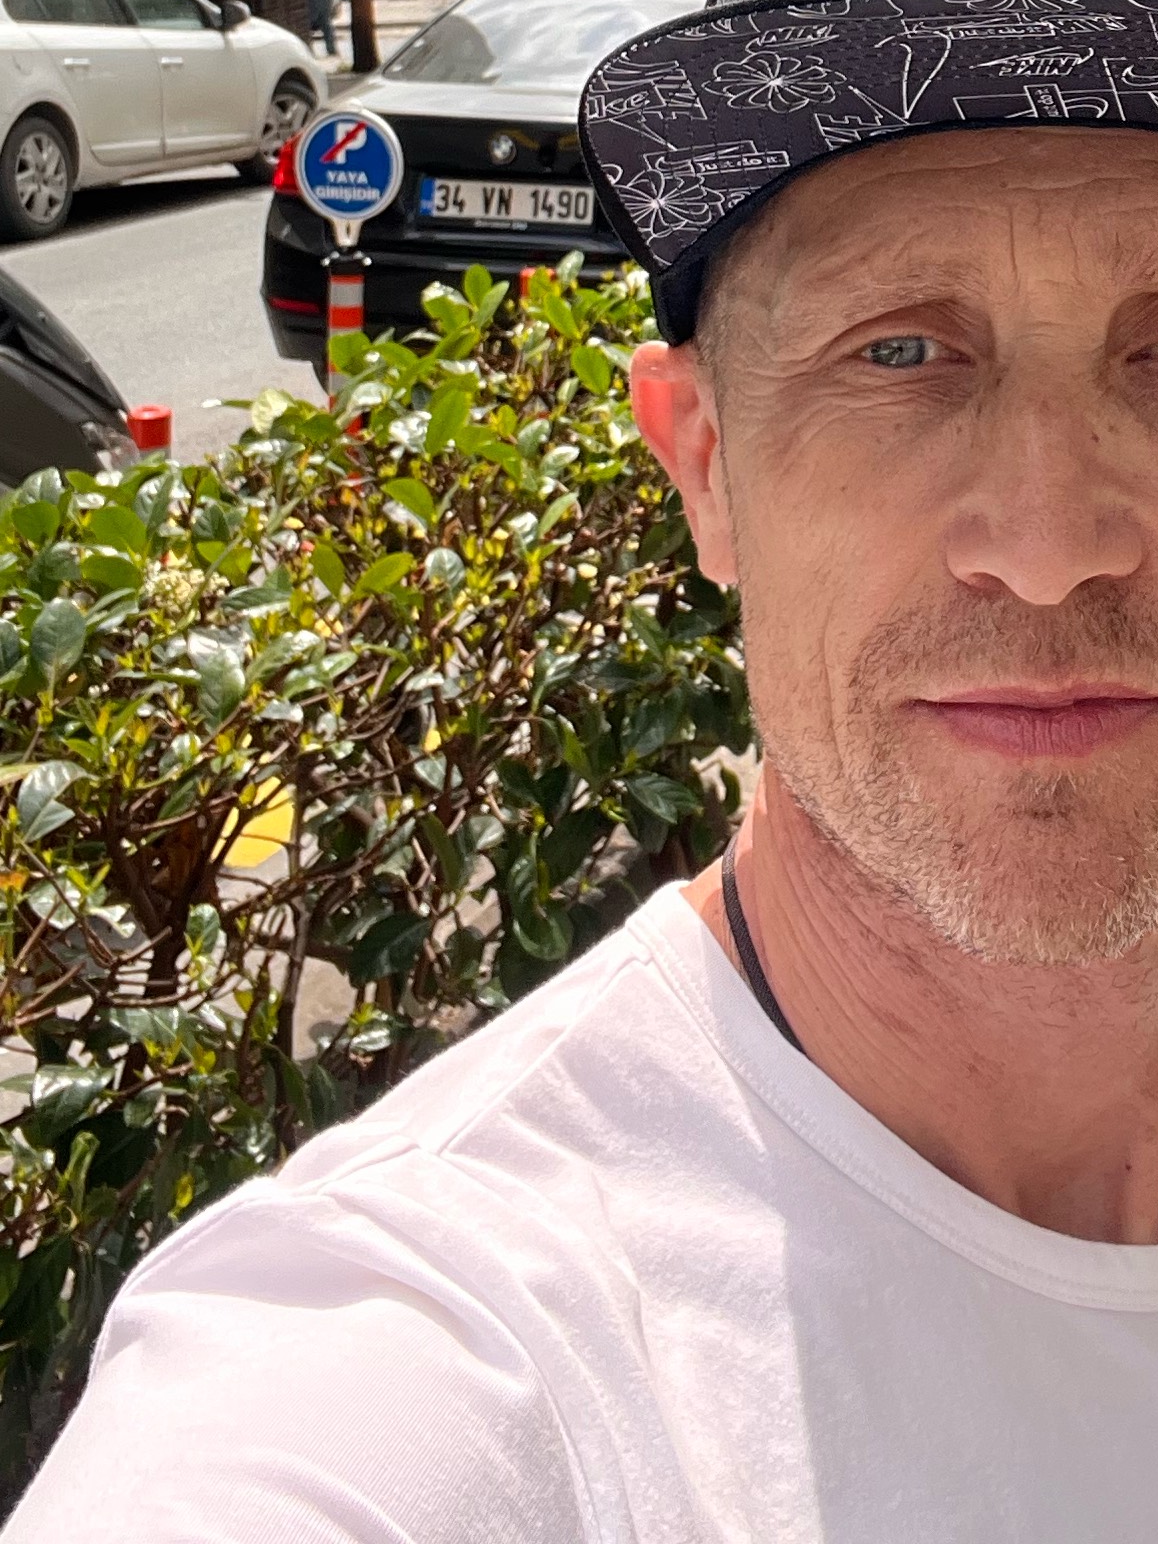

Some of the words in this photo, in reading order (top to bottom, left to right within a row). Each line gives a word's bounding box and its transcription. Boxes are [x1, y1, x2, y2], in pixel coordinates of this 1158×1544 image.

[326, 170, 368, 184] YAYA
[436, 184, 465, 213] 34
[482, 187, 513, 216] VN
[530, 189, 590, 221] 1490
